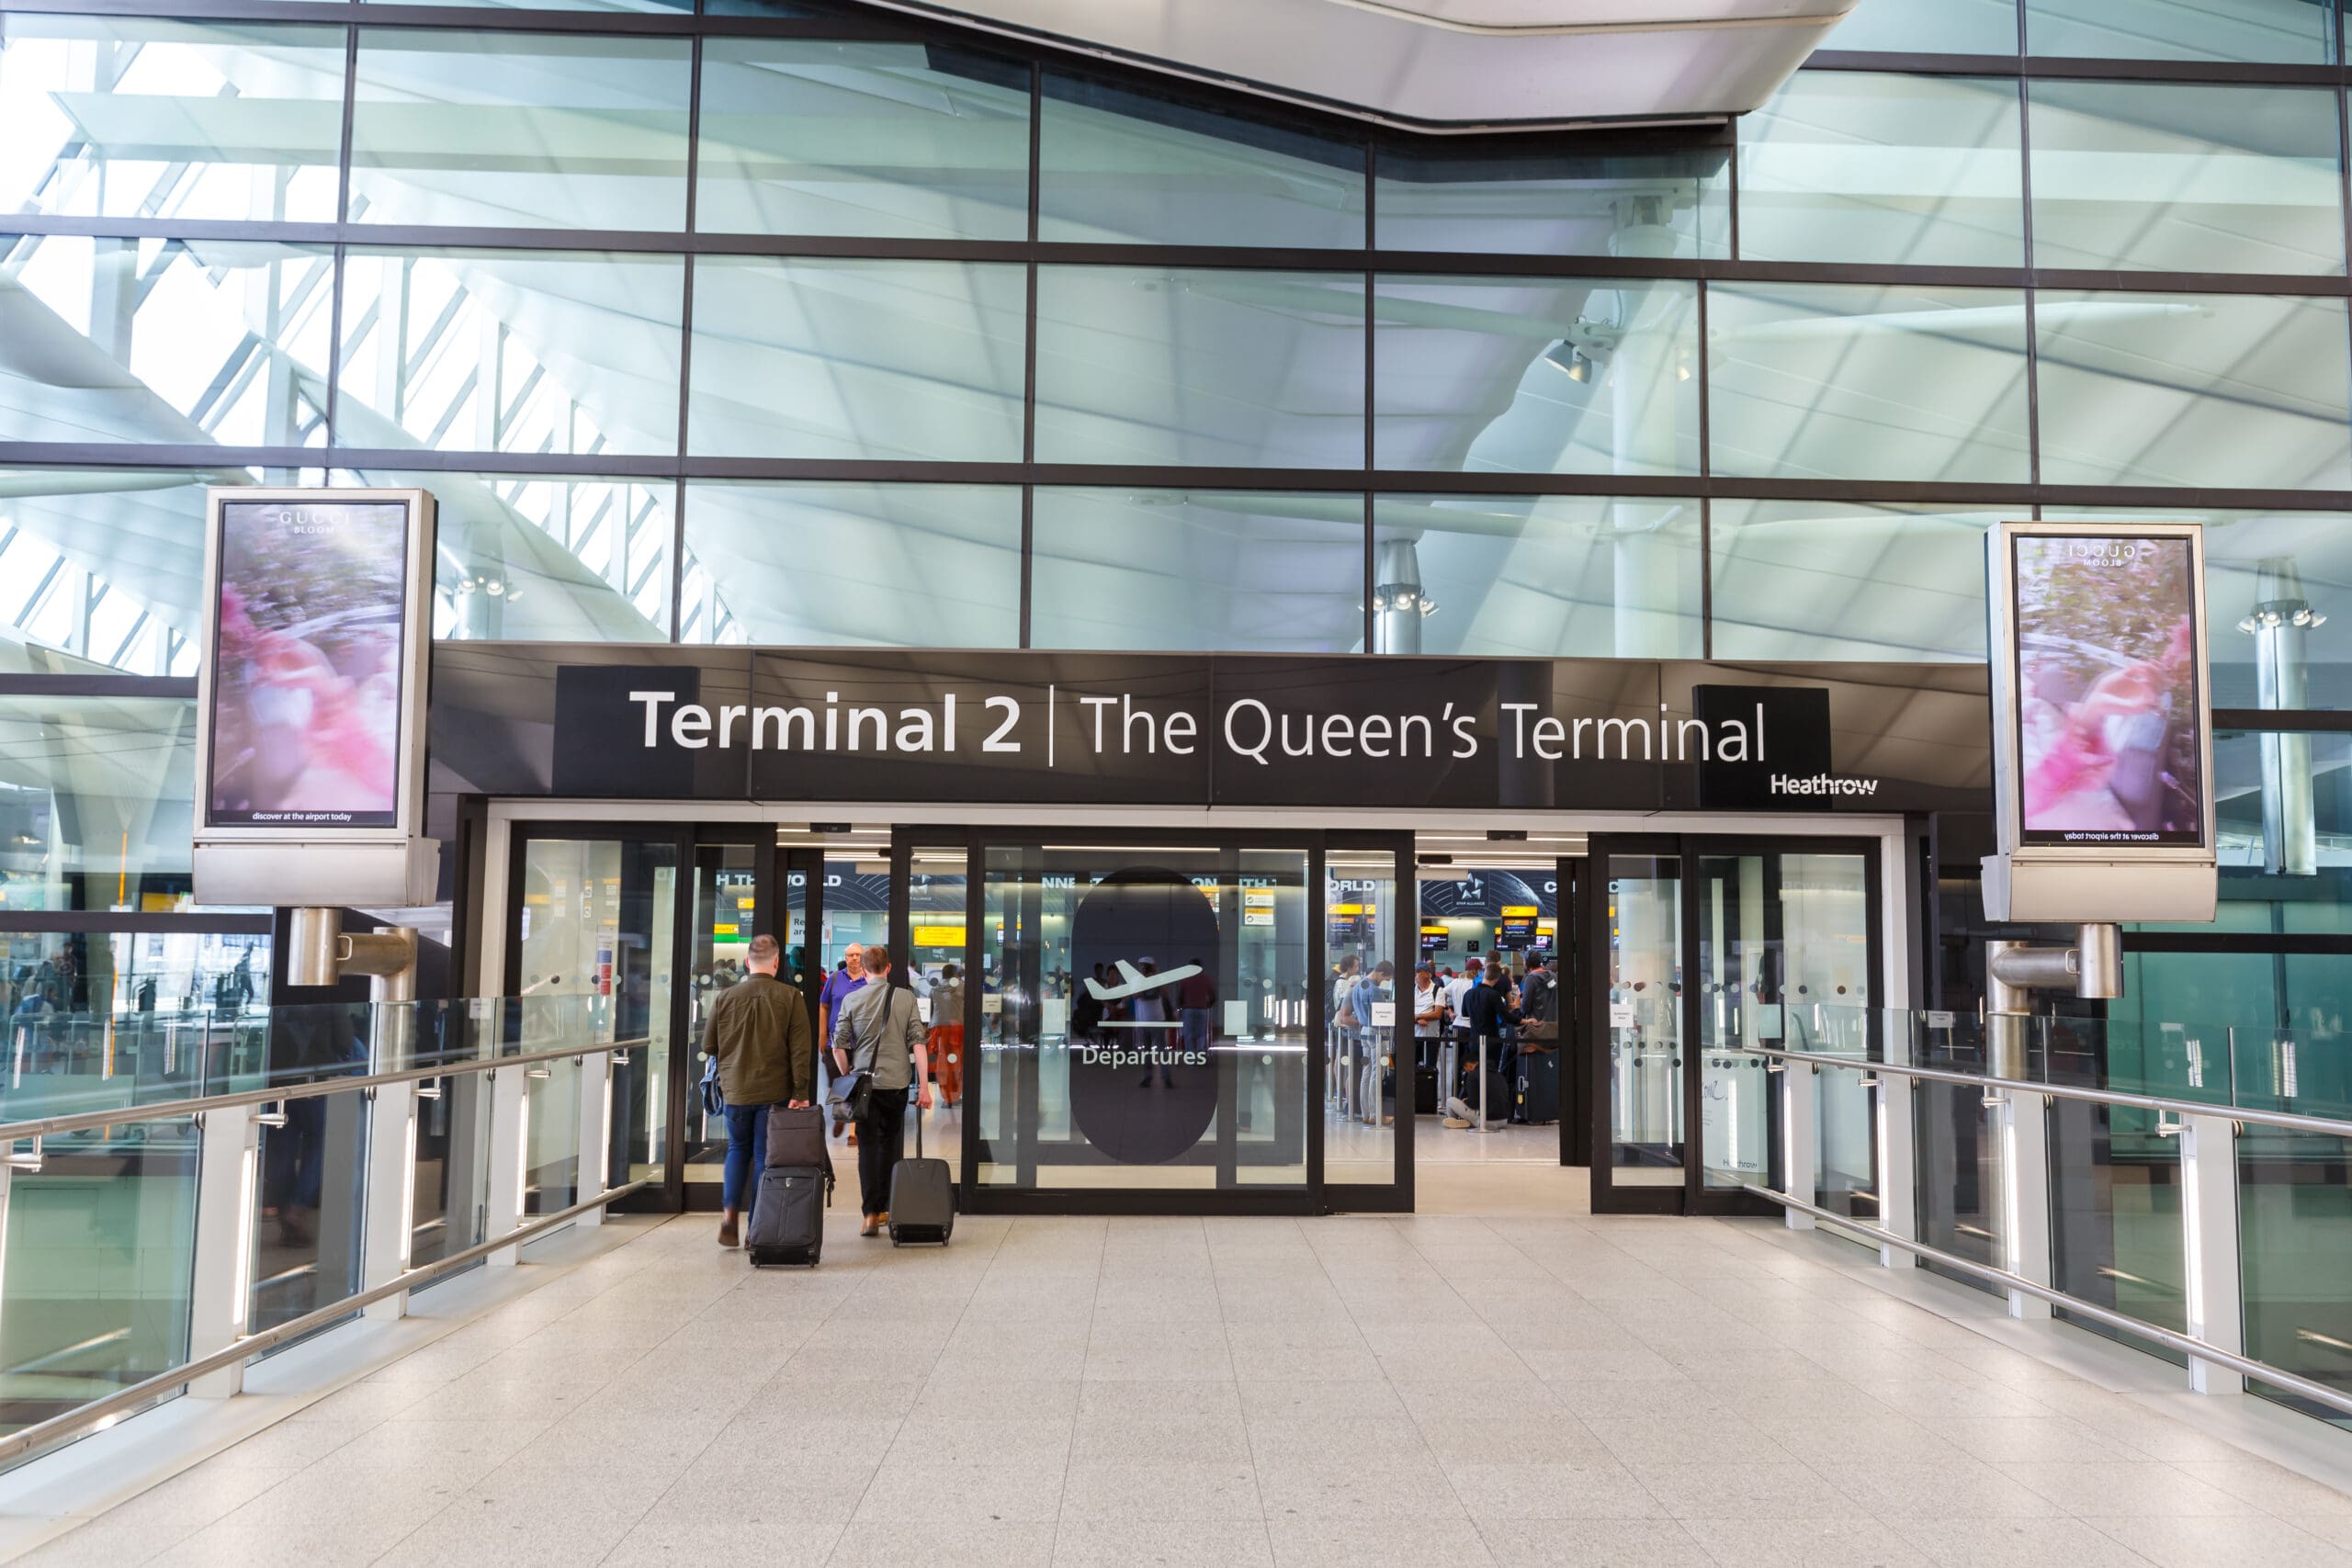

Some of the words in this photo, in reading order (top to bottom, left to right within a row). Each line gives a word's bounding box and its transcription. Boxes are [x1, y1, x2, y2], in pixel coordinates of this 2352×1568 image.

[279, 511, 349, 524] GUCCI
[629, 691, 956, 752] Terminal
[982, 695, 1021, 752] 2
[1080, 694, 1196, 754] The
[1225, 699, 1477, 765] Queen's
[1501, 703, 1764, 761] Terminal
[1770, 773, 1878, 795] Heathrow
[252, 812, 282, 820] discover
[292, 812, 304, 820] the
[305, 812, 330, 822] airport
[331, 812, 352, 822] today
[1082, 1047, 1207, 1069] Departures
